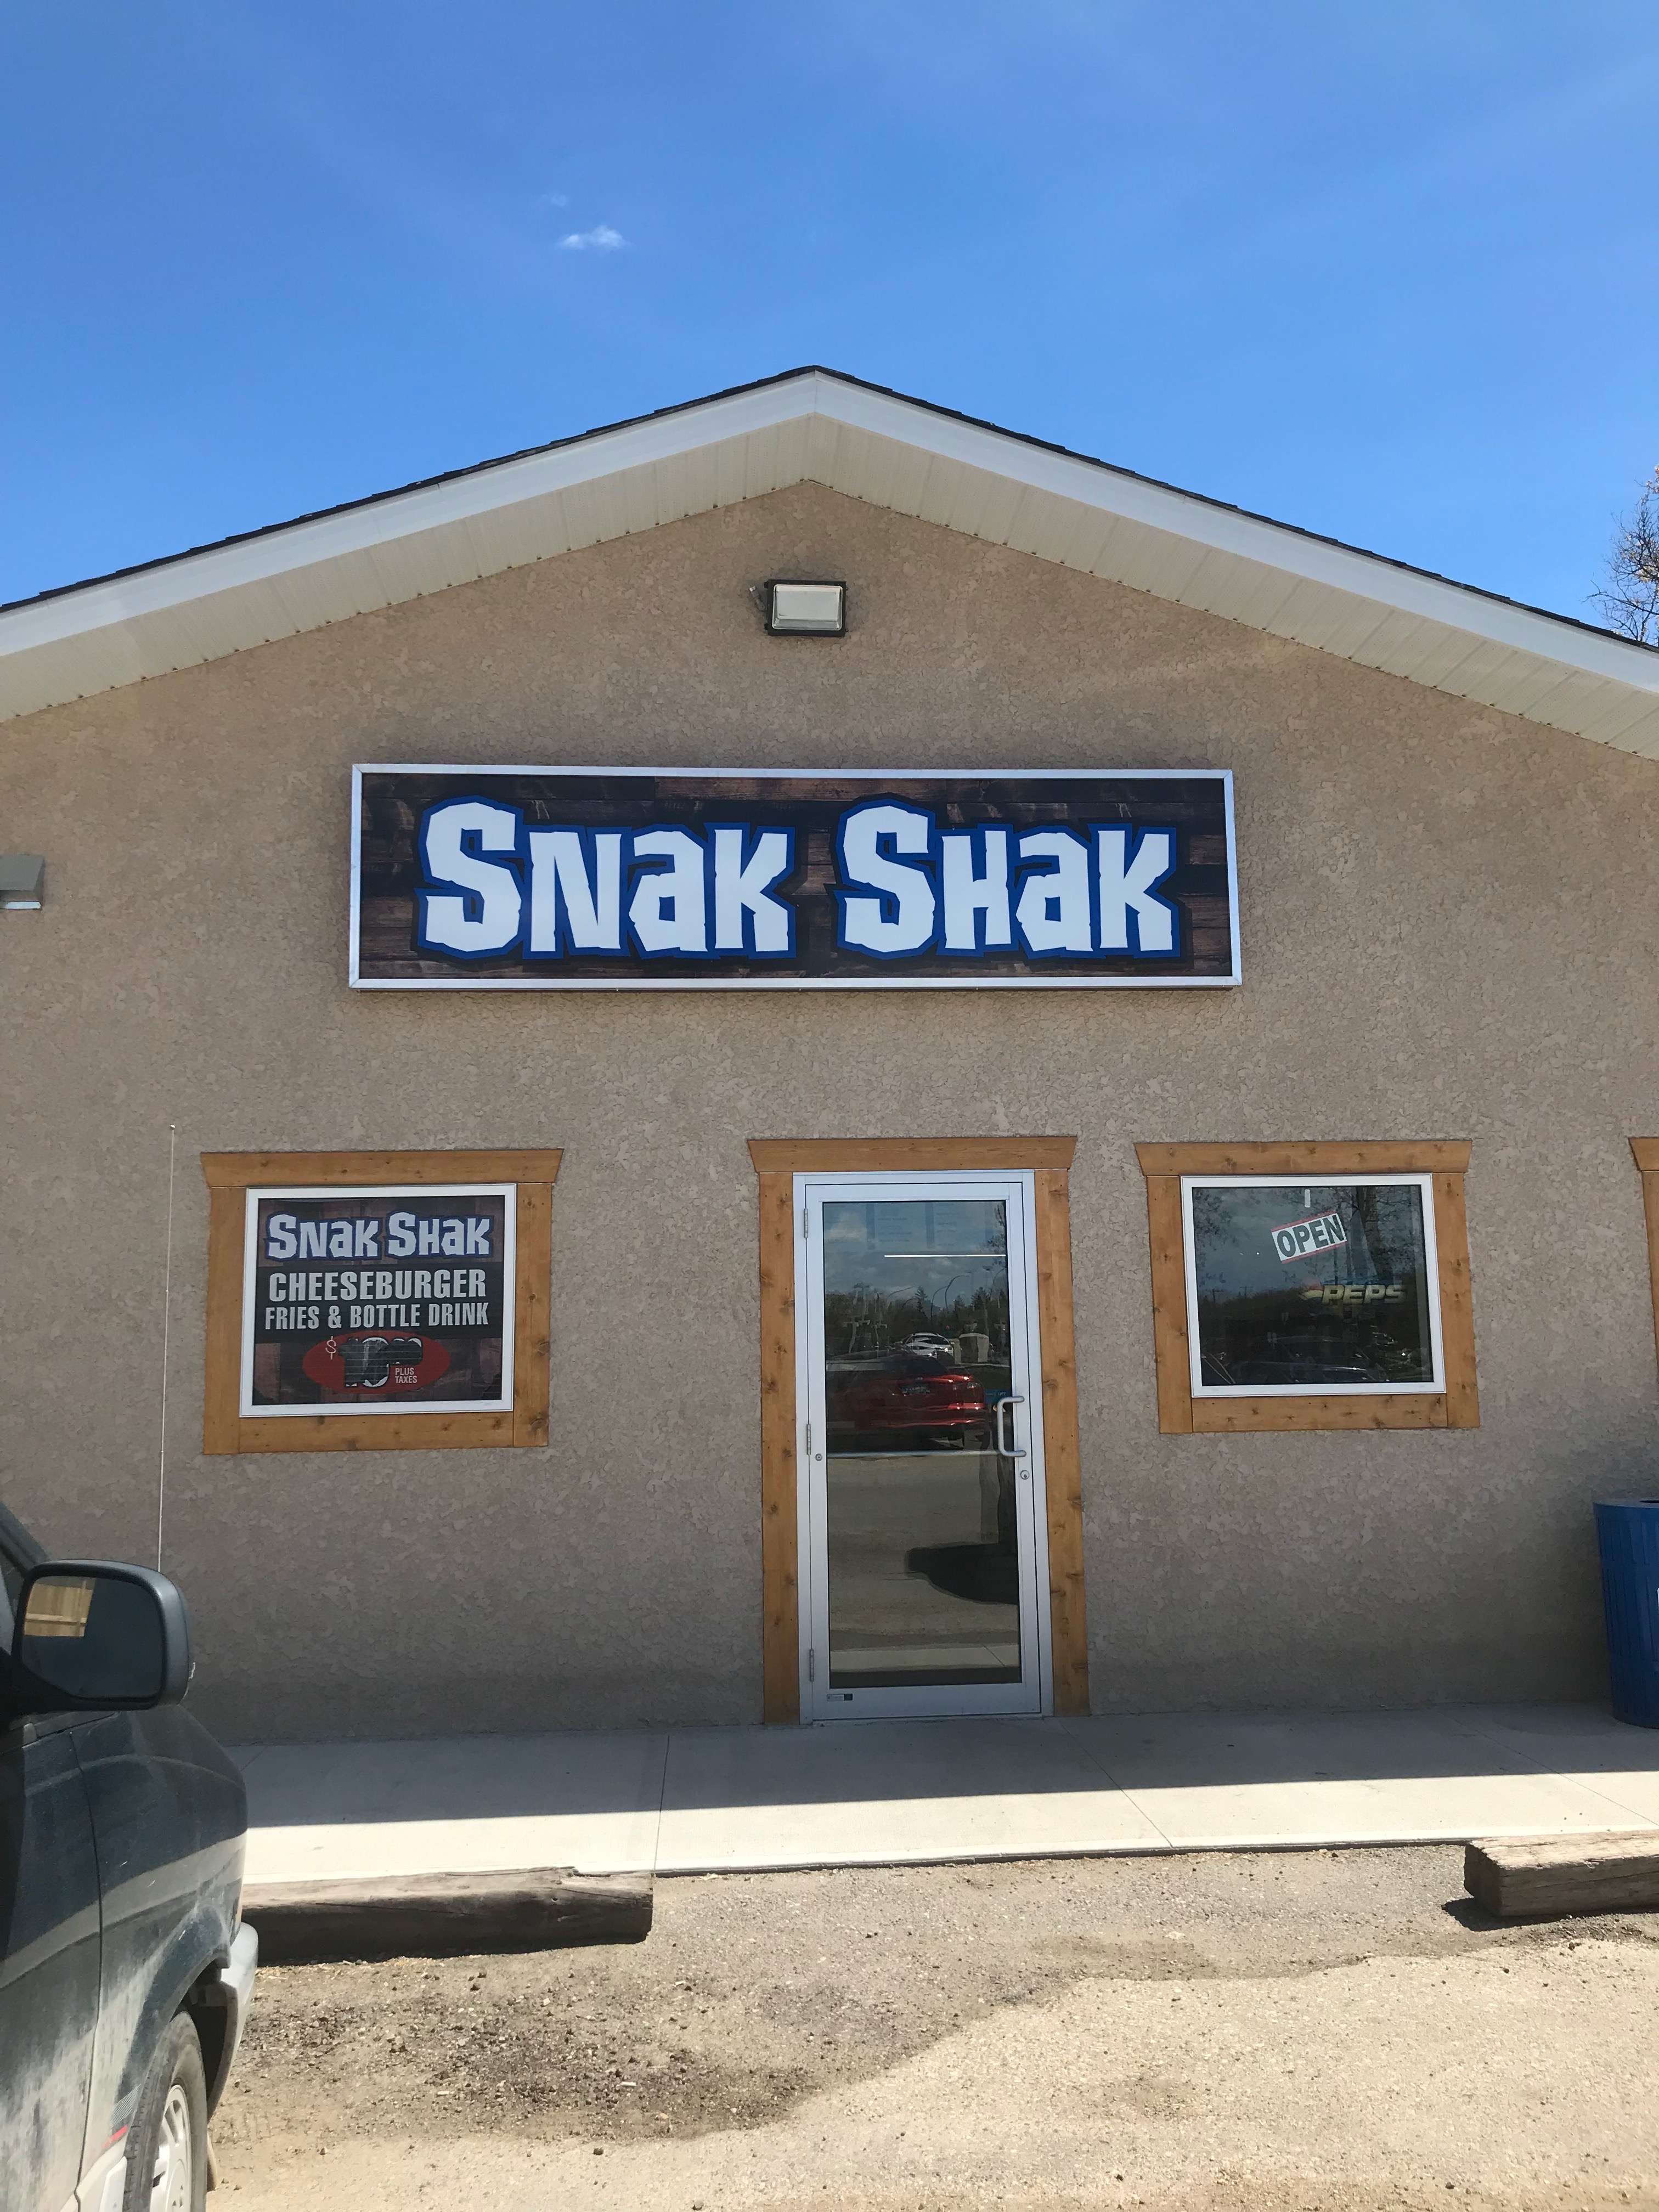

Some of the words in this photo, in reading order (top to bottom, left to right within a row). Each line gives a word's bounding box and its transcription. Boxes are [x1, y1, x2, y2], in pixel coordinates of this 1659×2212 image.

[1276, 1214, 1345, 1257] OPEN
[269, 1269, 486, 1302] CHEESEBURGER
[265, 1306, 319, 1330] FRIES
[328, 1305, 342, 1329] &
[350, 1304, 420, 1328] BOTTLE
[428, 1302, 489, 1326] DRINK
[395, 1367, 415, 1376] PLUS
[395, 1375, 417, 1384] TAXES
